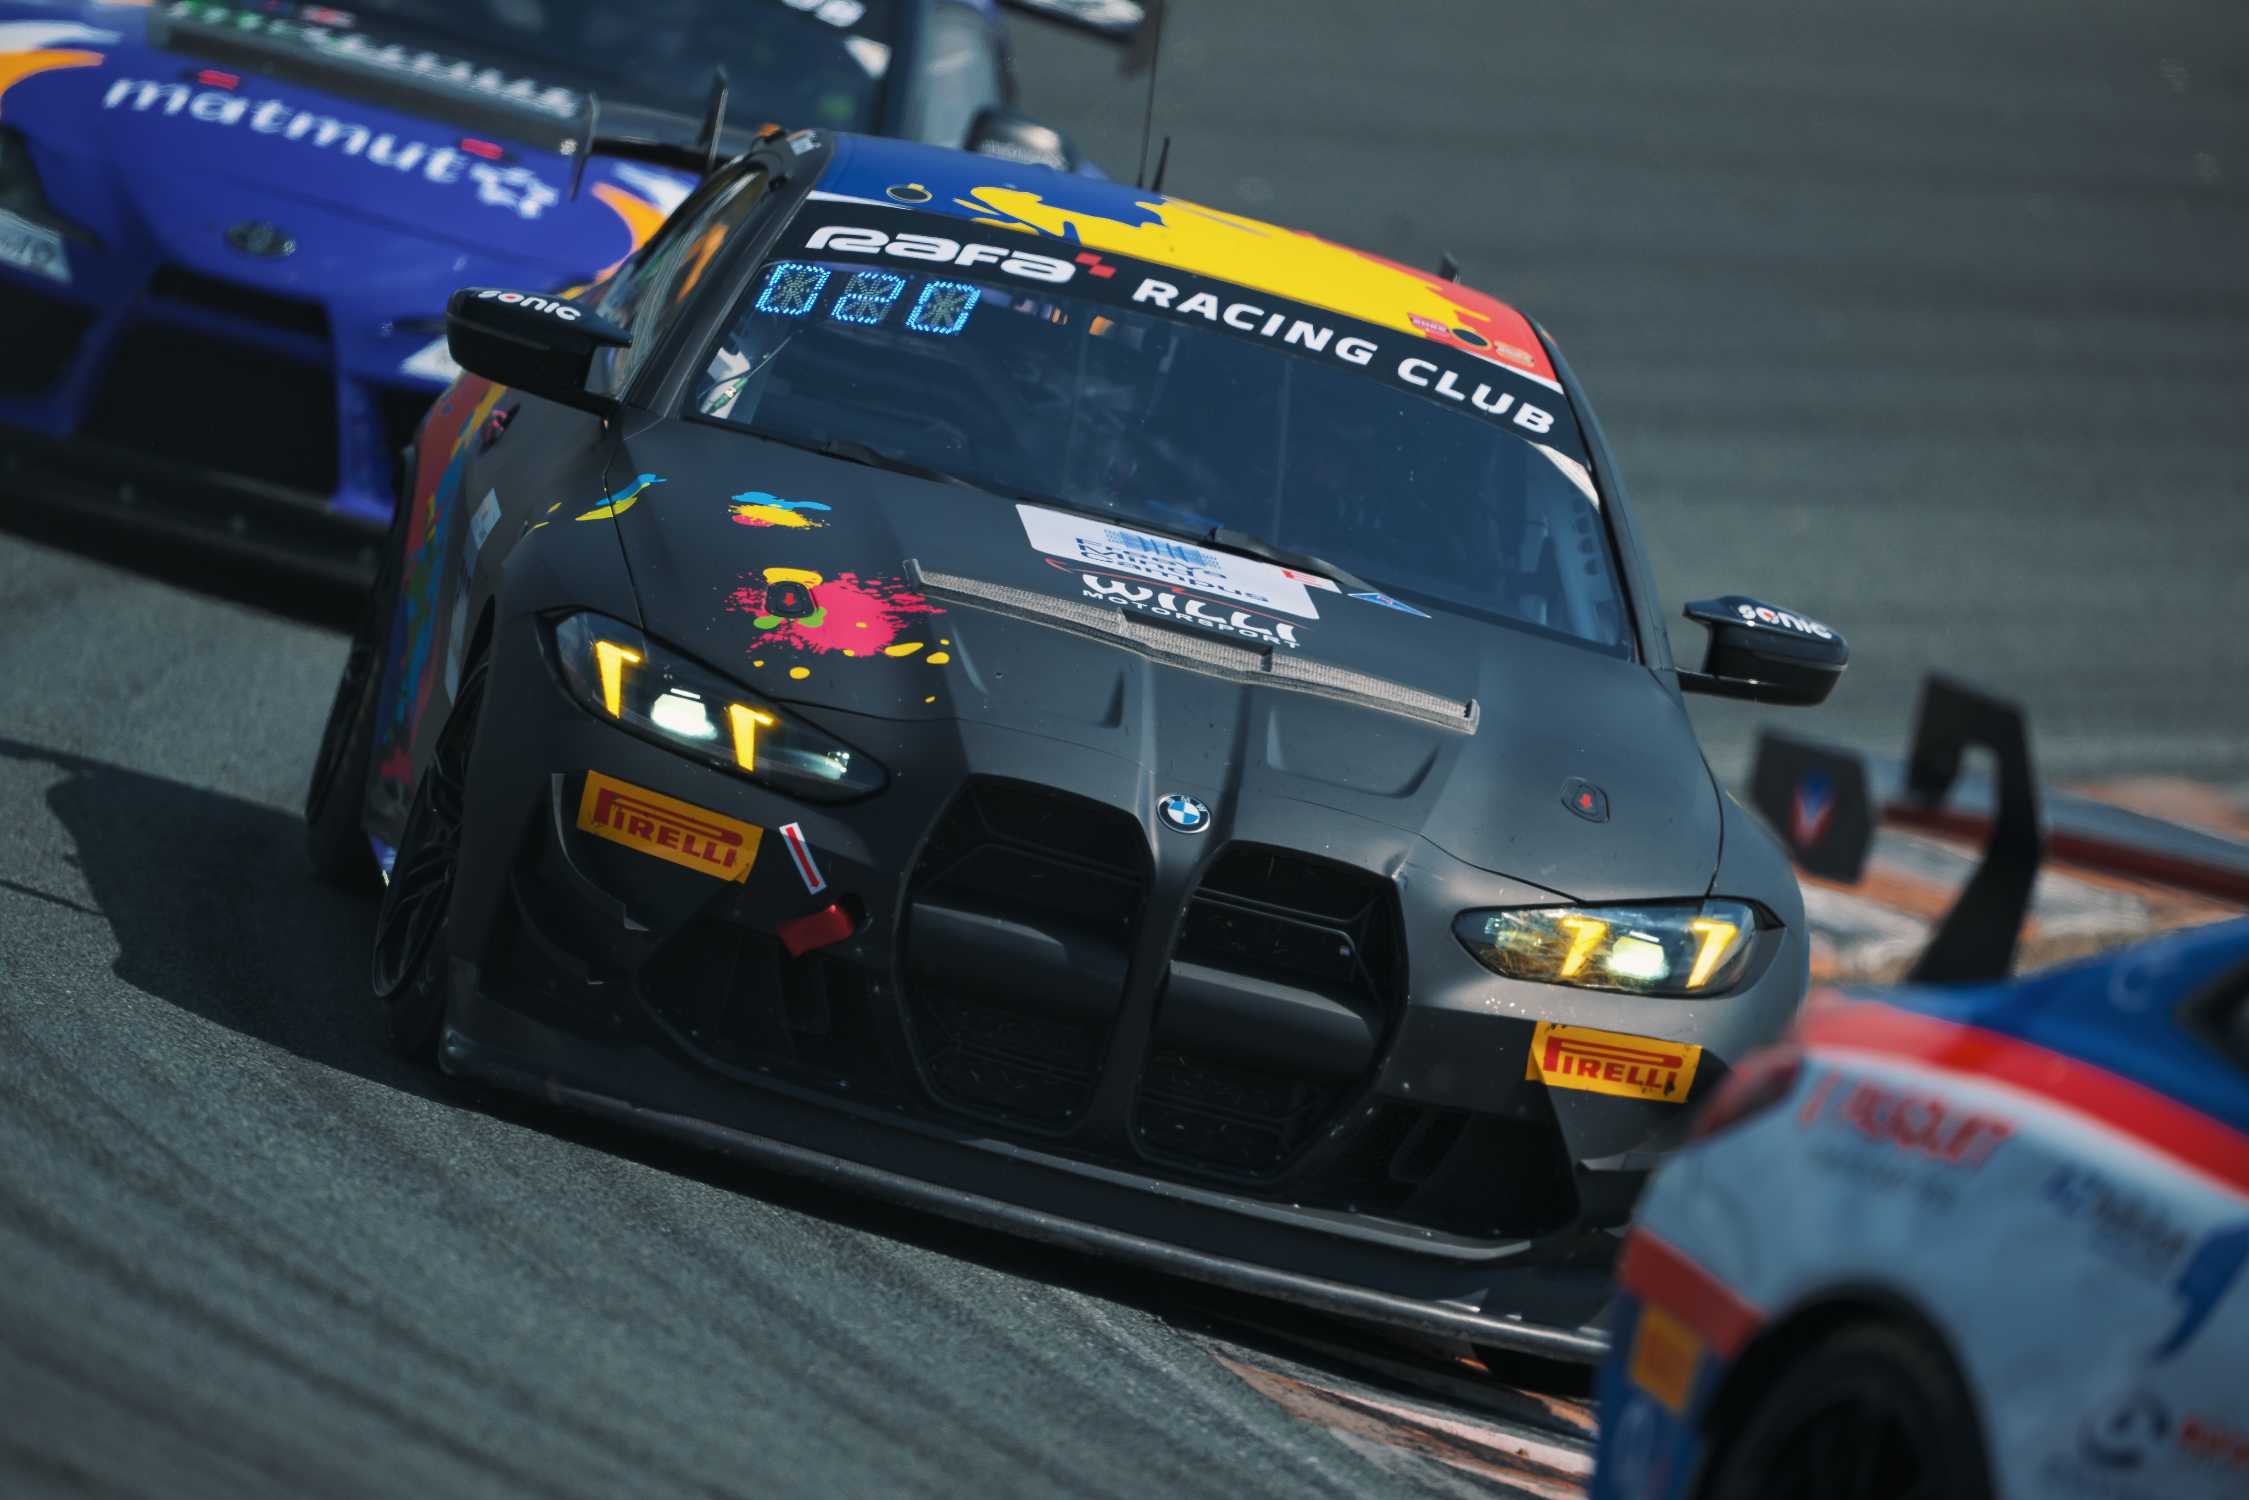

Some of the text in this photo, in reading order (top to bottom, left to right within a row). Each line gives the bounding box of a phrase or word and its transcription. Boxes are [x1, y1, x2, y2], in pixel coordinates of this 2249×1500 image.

[103, 79, 463, 183] matmut
[477, 290, 582, 321] sonic
[755, 262, 982, 335] 020
[1133, 278, 1379, 366] RACING
[1397, 357, 1555, 434] CLUB
[1082, 574, 1298, 643] WILLI
[1082, 589, 1301, 649] MOTORSPORT
[593, 787, 744, 869] PIRELLI
[1542, 1035, 1684, 1096] PIRELLI
